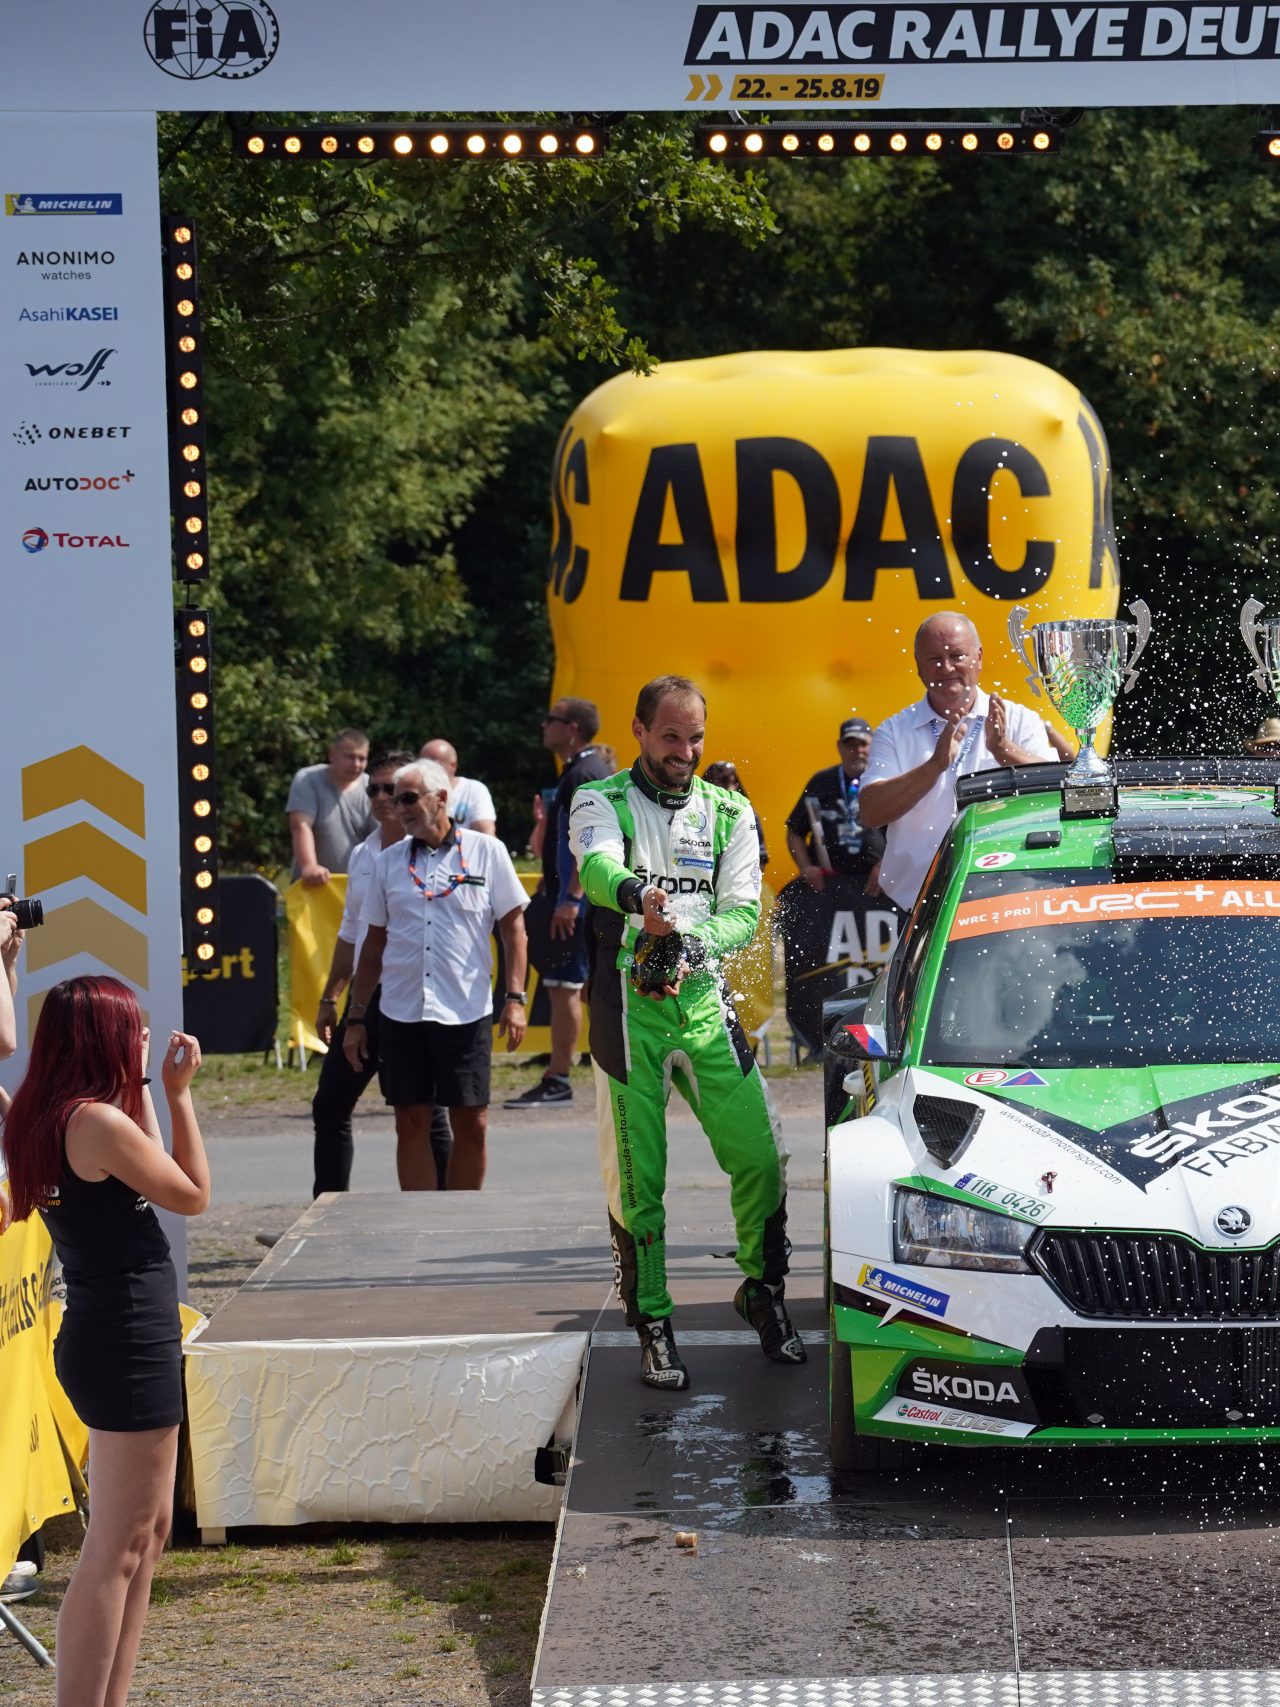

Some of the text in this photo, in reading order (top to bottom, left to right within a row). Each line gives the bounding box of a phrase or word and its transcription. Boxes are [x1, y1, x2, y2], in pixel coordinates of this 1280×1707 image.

[695, 10, 876, 60] ADAC
[888, 8, 1130, 60] RALLYE
[736, 78, 772, 98] 22.
[794, 78, 881, 98] 25.8.19
[37, 199, 113, 210] MICHELIN
[16, 250, 116, 266] ANONIMO
[40, 270, 92, 281] watches
[48, 426, 132, 440] ONEBET
[618, 435, 1057, 605] ADAC
[52, 532, 130, 548] TOTAL
[957, 907, 1032, 927] WRC 2 PRO
[617, 1094, 638, 1210] www.skoda-auto.com
[999, 1108, 1123, 1186] www.skoda-motorsport.com
[1001, 1193, 1047, 1217] 0426
[882, 1279, 942, 1308] MICHELIN
[912, 1367, 1021, 1404] ŠKODA
[905, 1404, 942, 1423] Castrol
